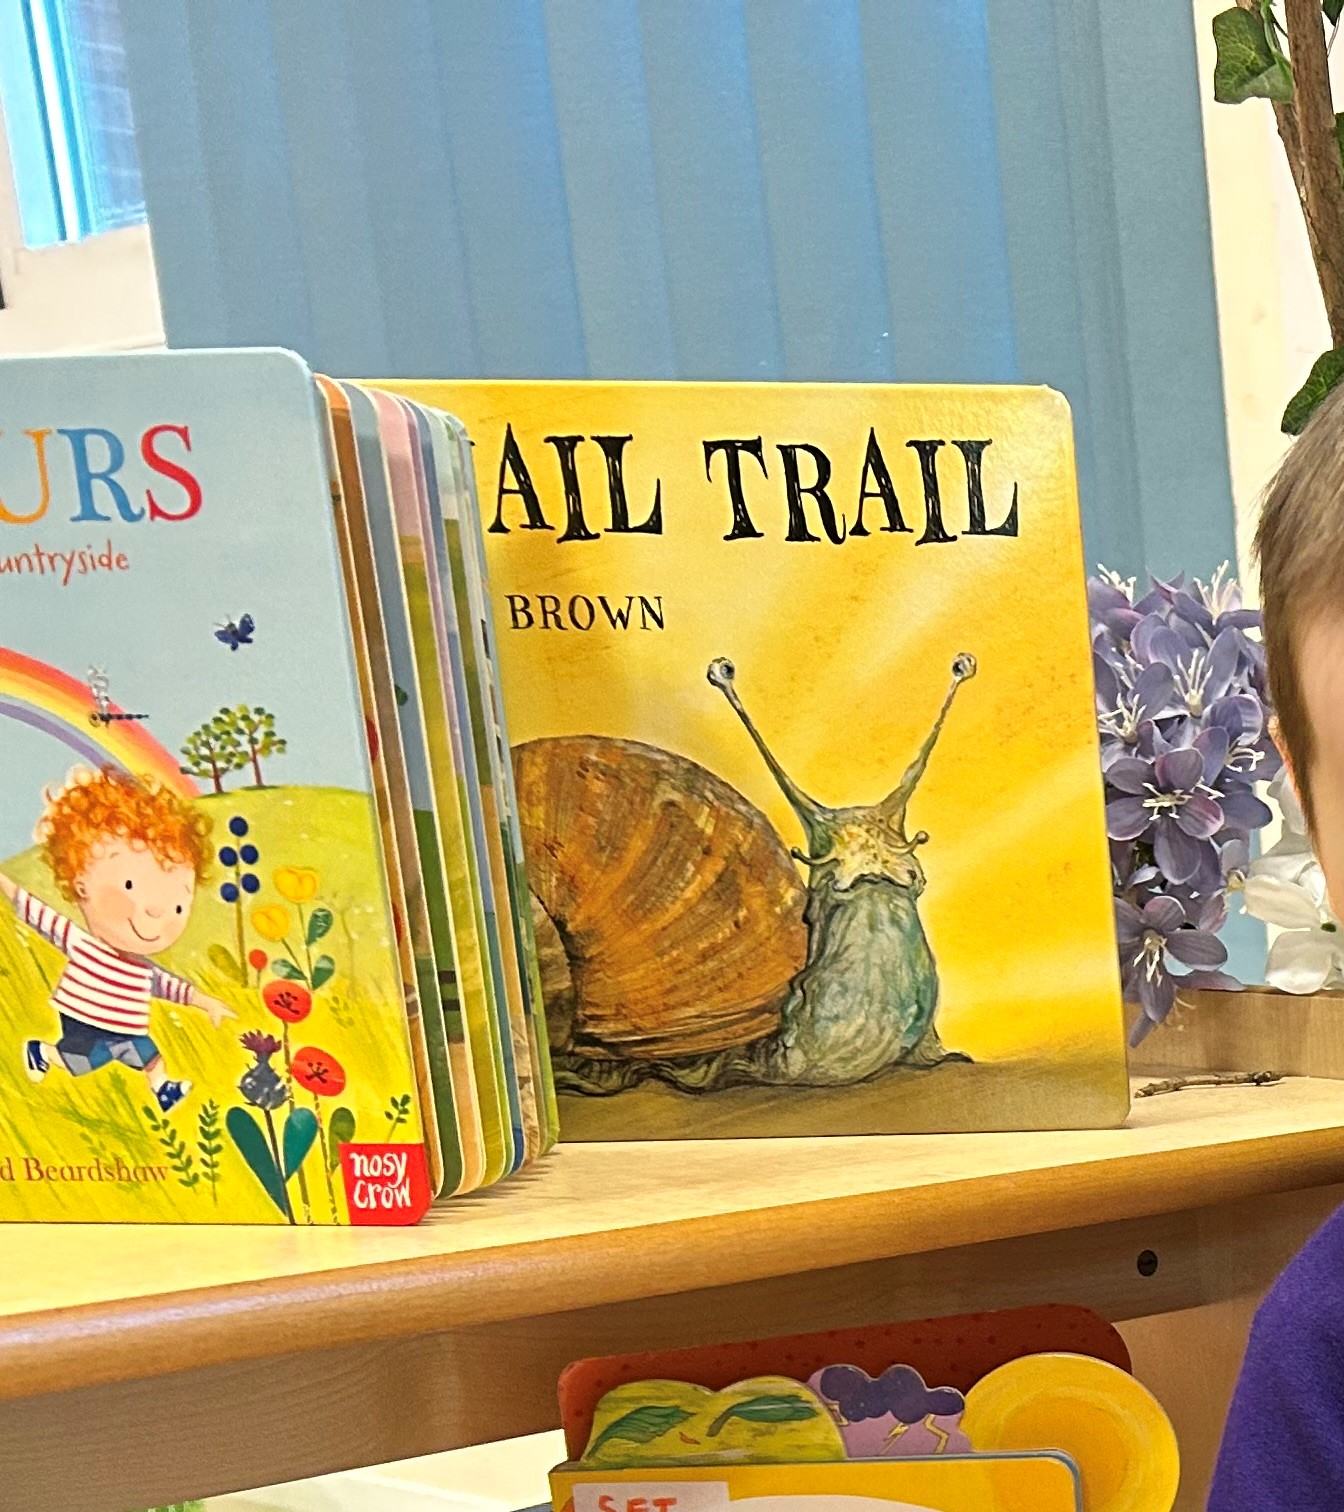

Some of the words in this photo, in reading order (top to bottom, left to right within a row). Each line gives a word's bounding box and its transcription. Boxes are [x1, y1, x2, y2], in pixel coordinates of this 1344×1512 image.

[470, 423, 663, 544] AIL
[703, 426, 1019, 546] TRAIL
[504, 594, 665, 631] BROWN
[22, 1157, 169, 1182] Beardshaw
[349, 1152, 408, 1189] nosy
[353, 1177, 412, 1210] crow
